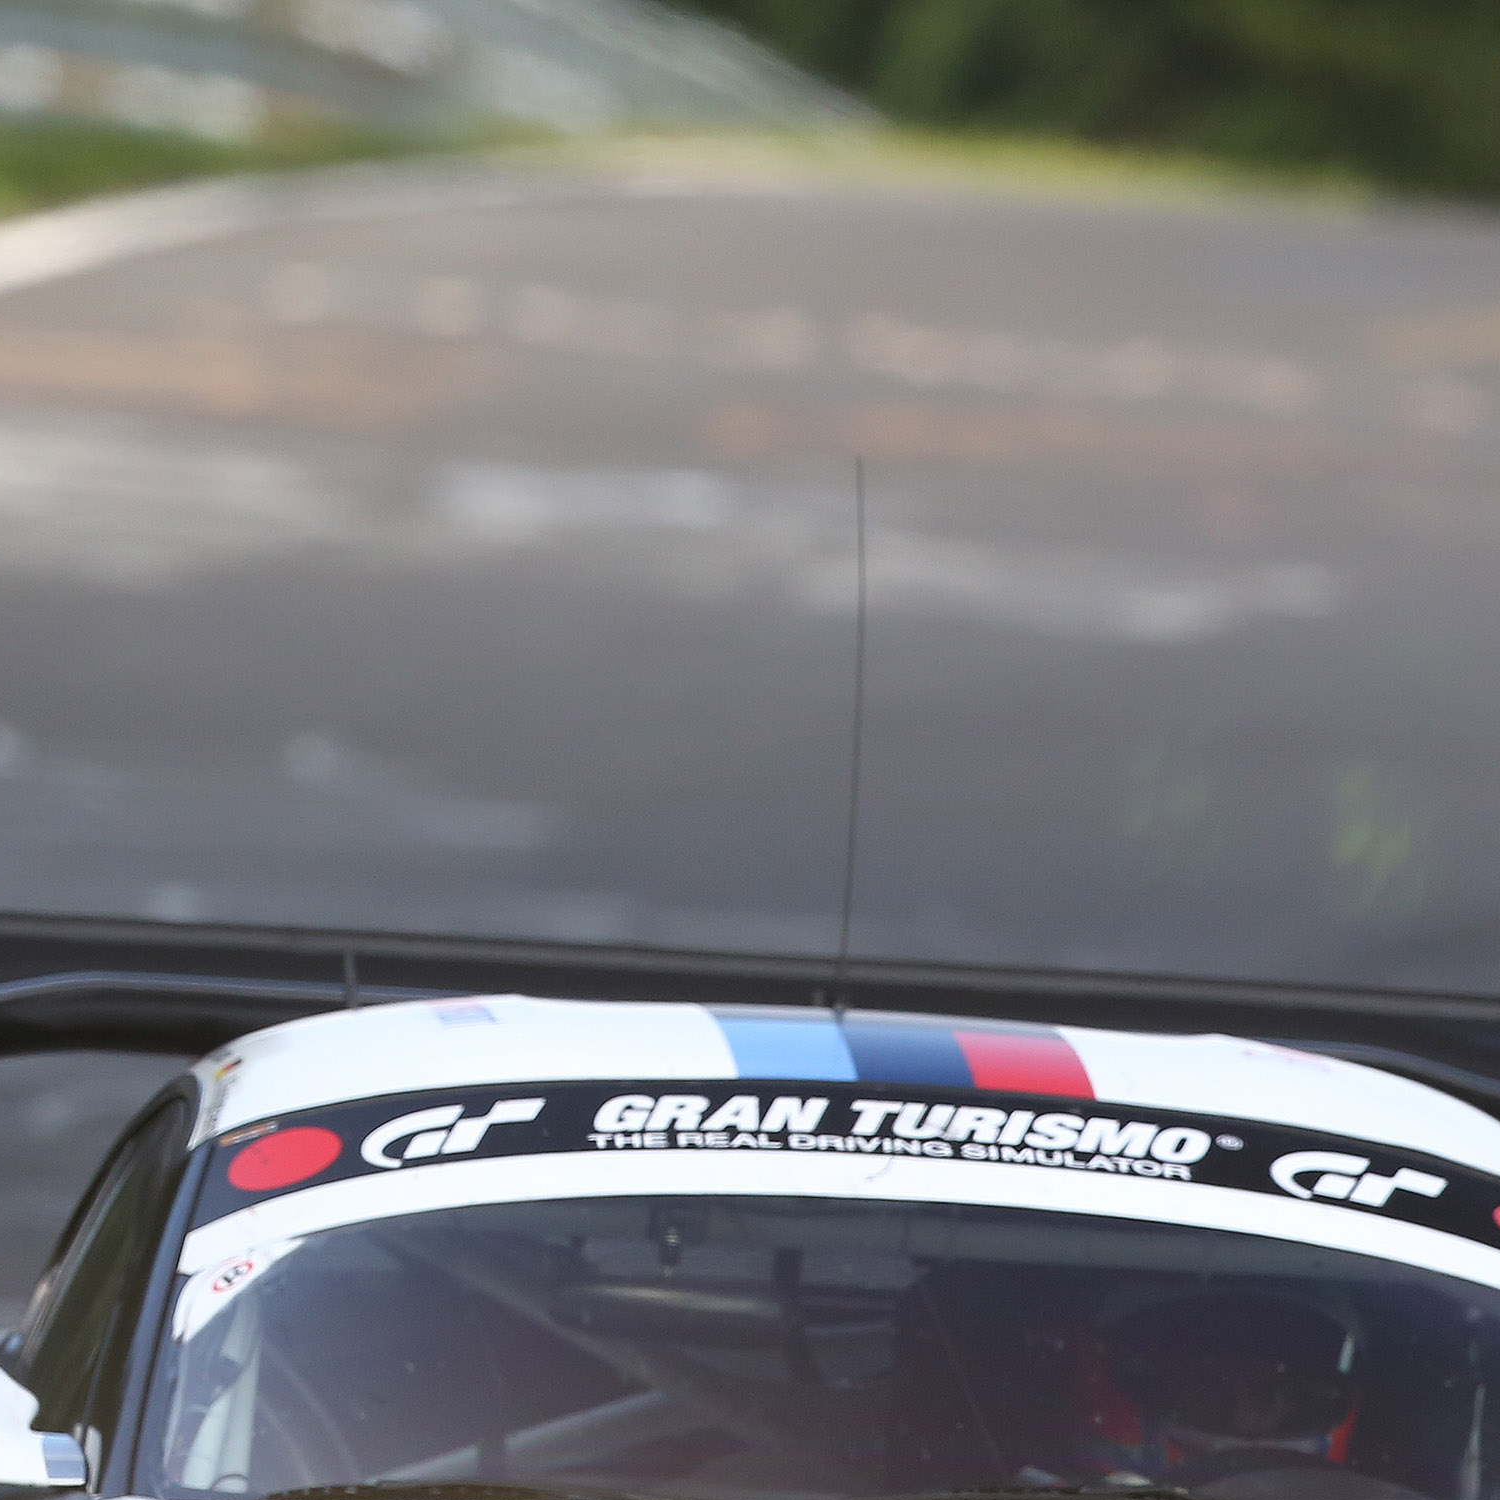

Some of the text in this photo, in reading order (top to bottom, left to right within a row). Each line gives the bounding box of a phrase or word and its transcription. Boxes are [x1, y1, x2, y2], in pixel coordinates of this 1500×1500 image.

[592, 1093, 831, 1132] GRAN
[586, 1131, 1193, 1182] THE REAL DRIVING SIMULATOR
